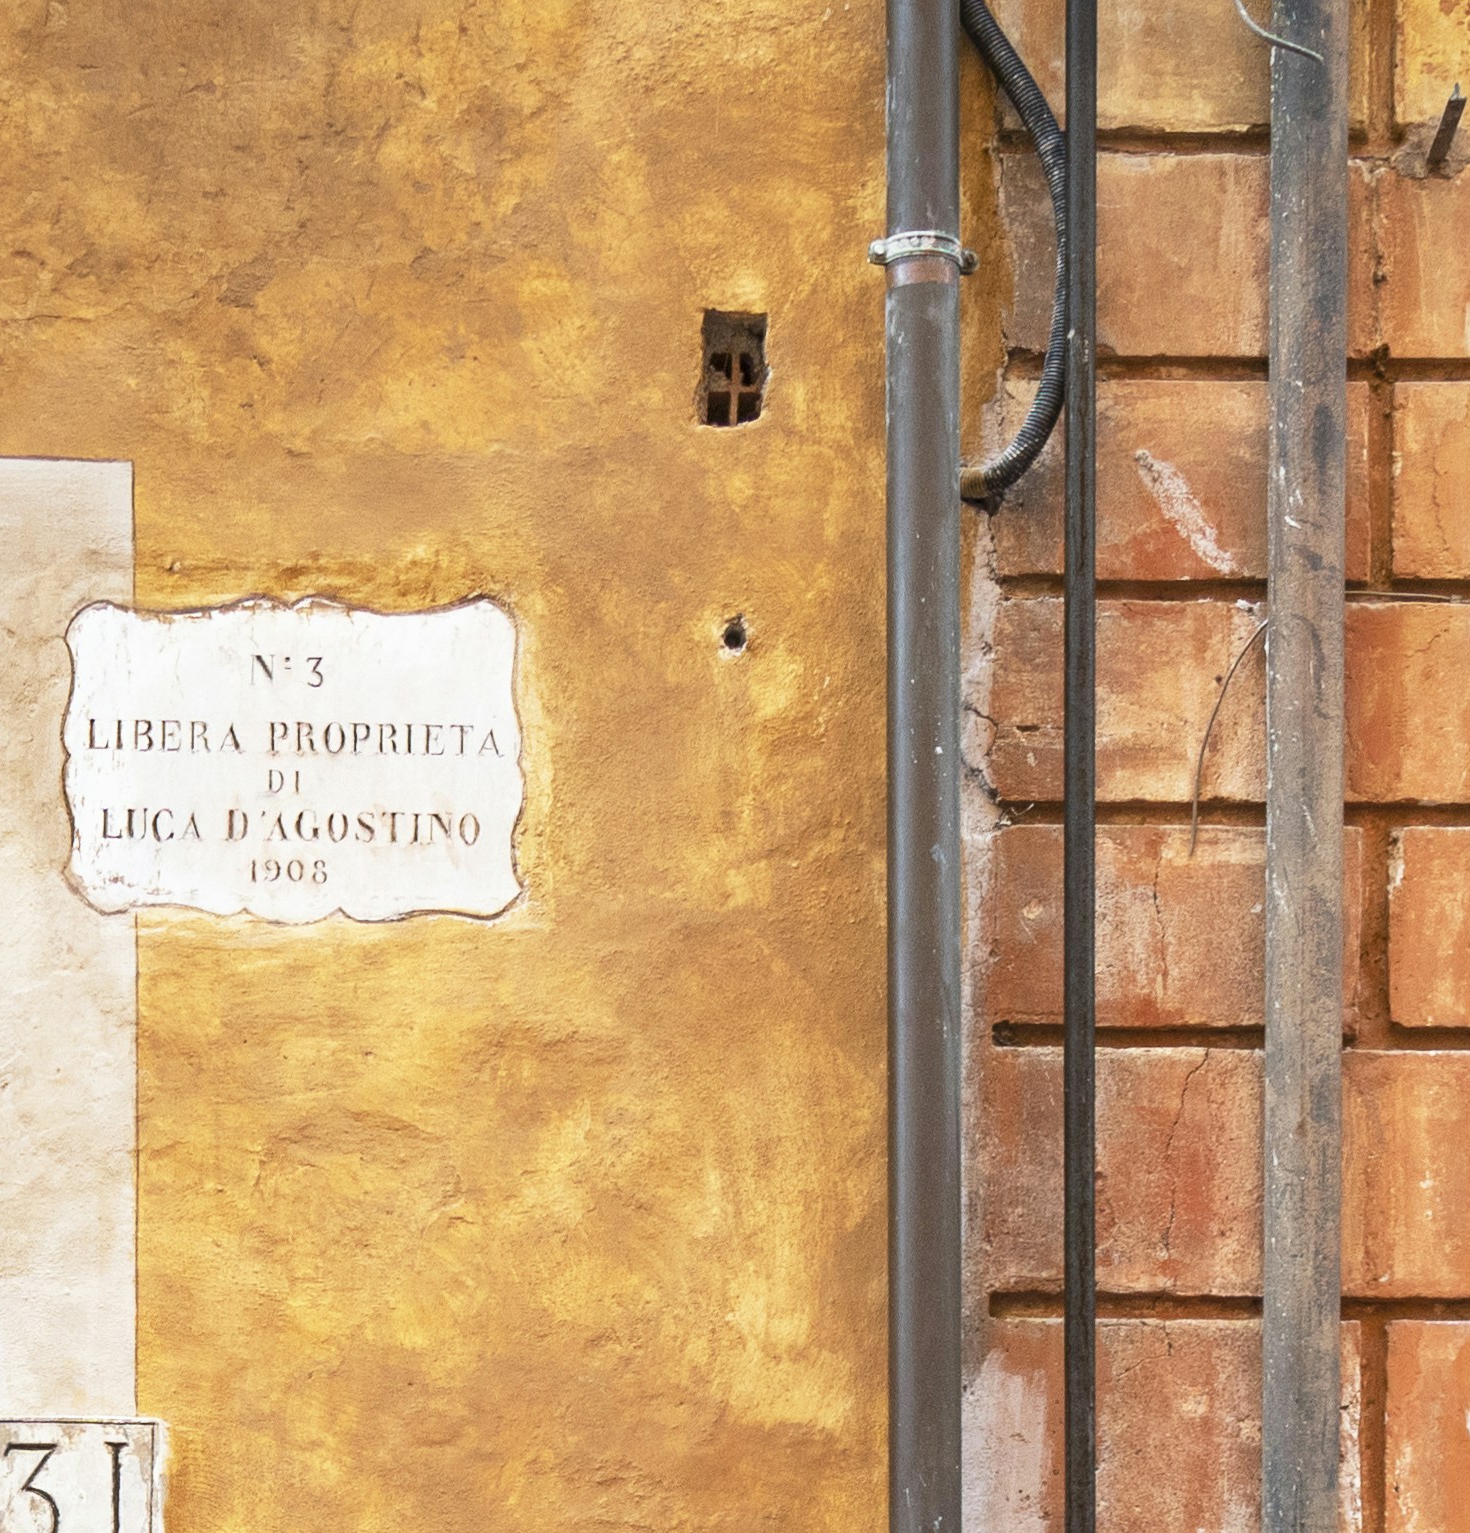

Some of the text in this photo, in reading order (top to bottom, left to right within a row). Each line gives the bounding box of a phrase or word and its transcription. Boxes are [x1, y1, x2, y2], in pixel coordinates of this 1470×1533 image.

[306, 656, 324, 688] 3
[87, 717, 246, 755] LIBERA
[267, 768, 300, 795] DI
[101, 808, 482, 847] LUCA D'AGOSTINO
[249, 859, 329, 885] 1908
